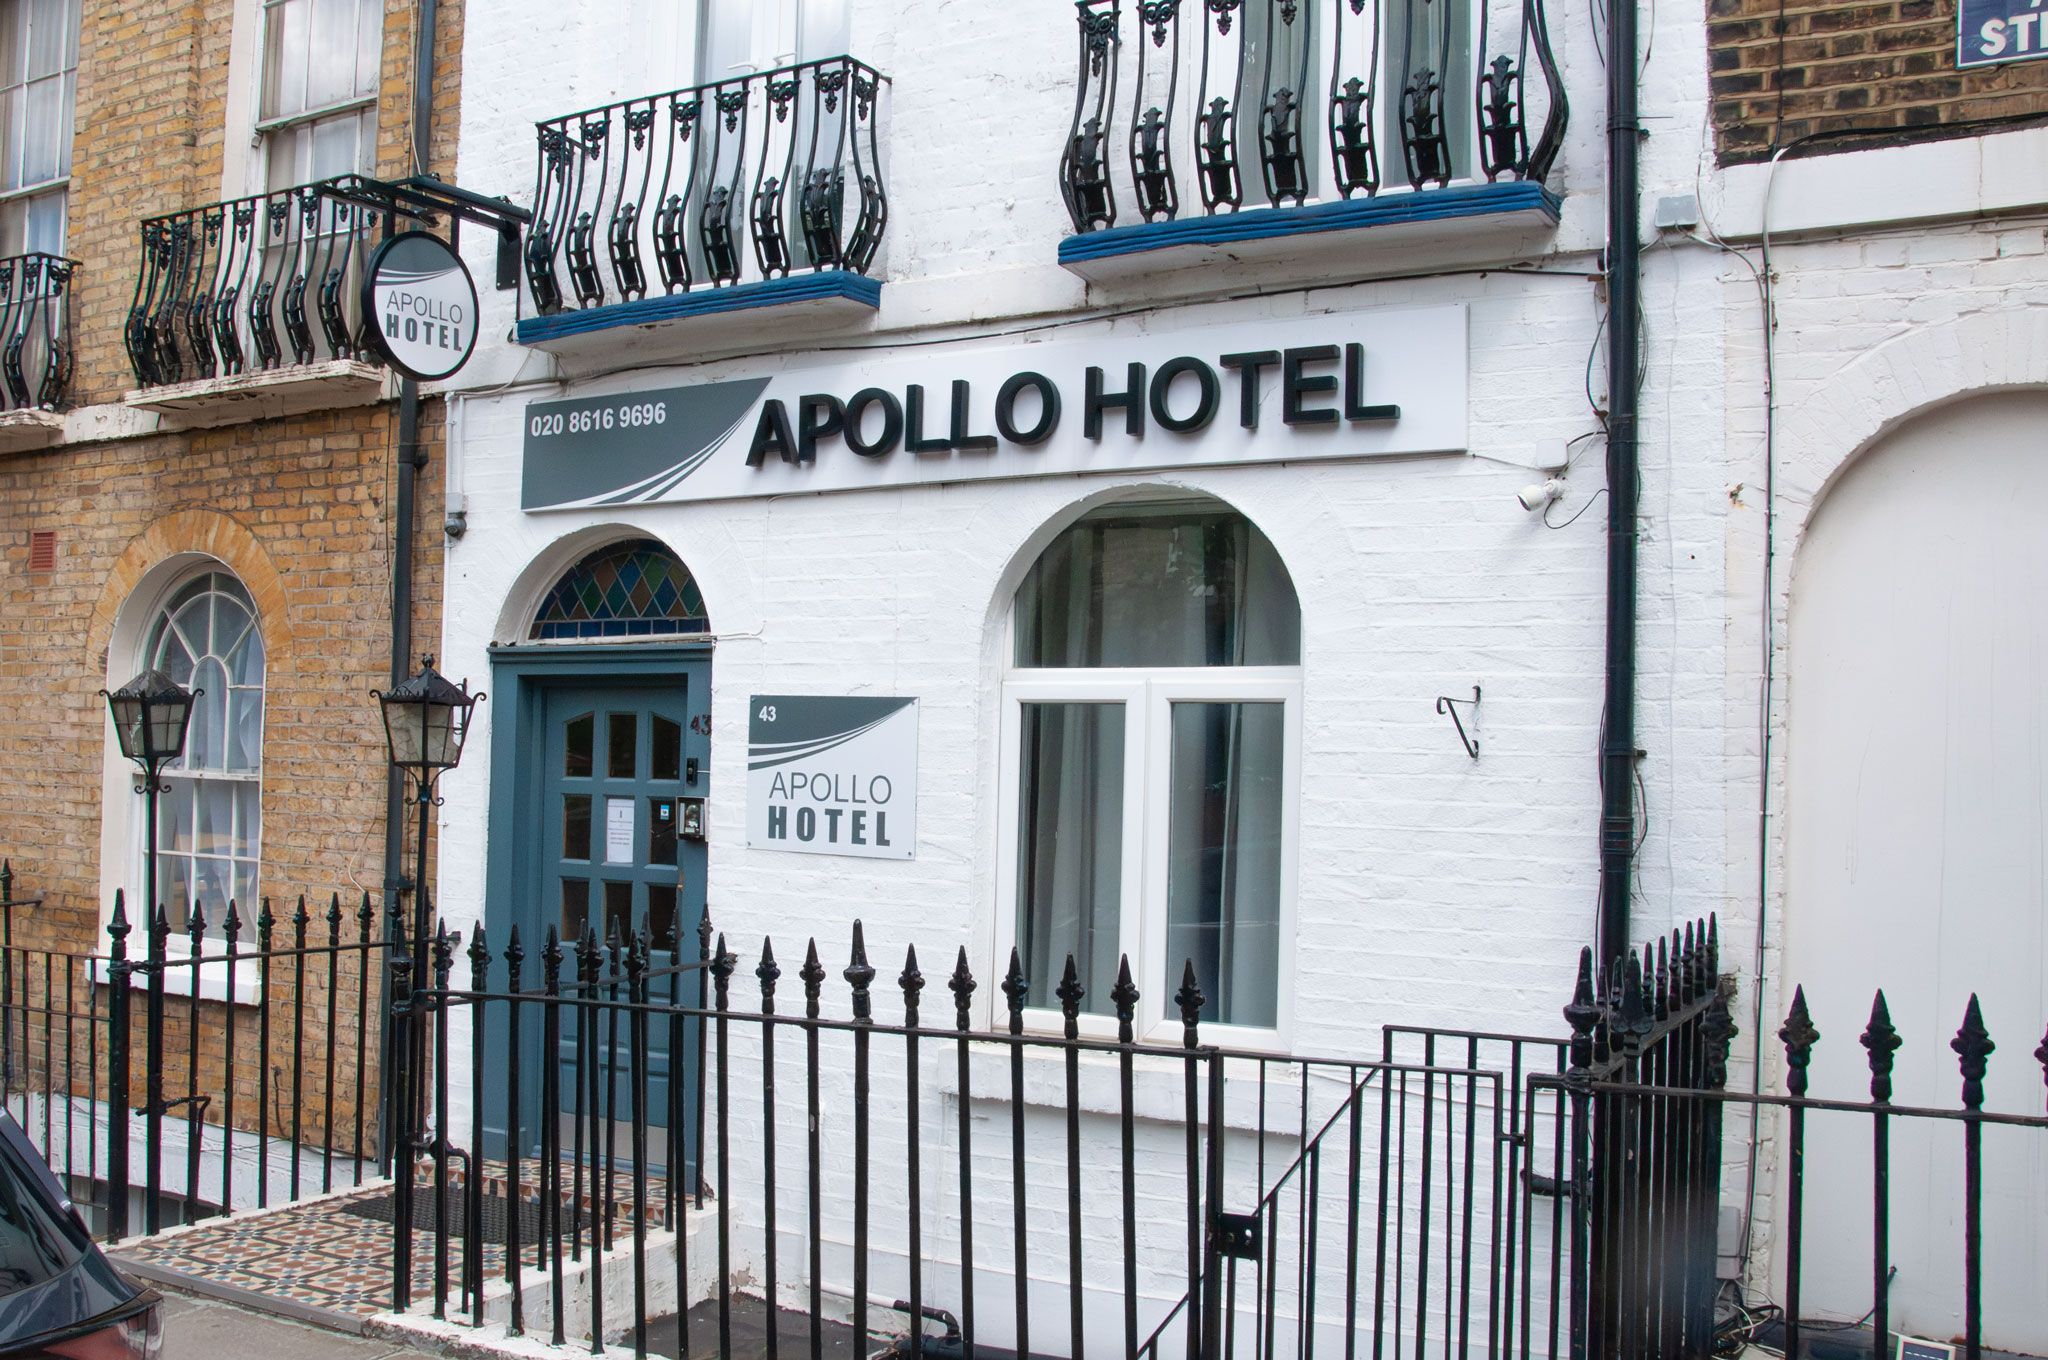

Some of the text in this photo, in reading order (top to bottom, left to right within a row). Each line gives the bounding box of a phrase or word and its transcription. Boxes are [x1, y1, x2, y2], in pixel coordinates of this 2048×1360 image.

[386, 290, 463, 324] APOLLO
[386, 313, 462, 352] HOTEL
[531, 402, 667, 437] 020 8616 9696
[745, 342, 1400, 468] APOLLO HOTEL
[689, 714, 712, 736] 43
[758, 705, 777, 722] 43
[768, 771, 892, 805] APOLLO
[767, 805, 891, 847] HOTEL
